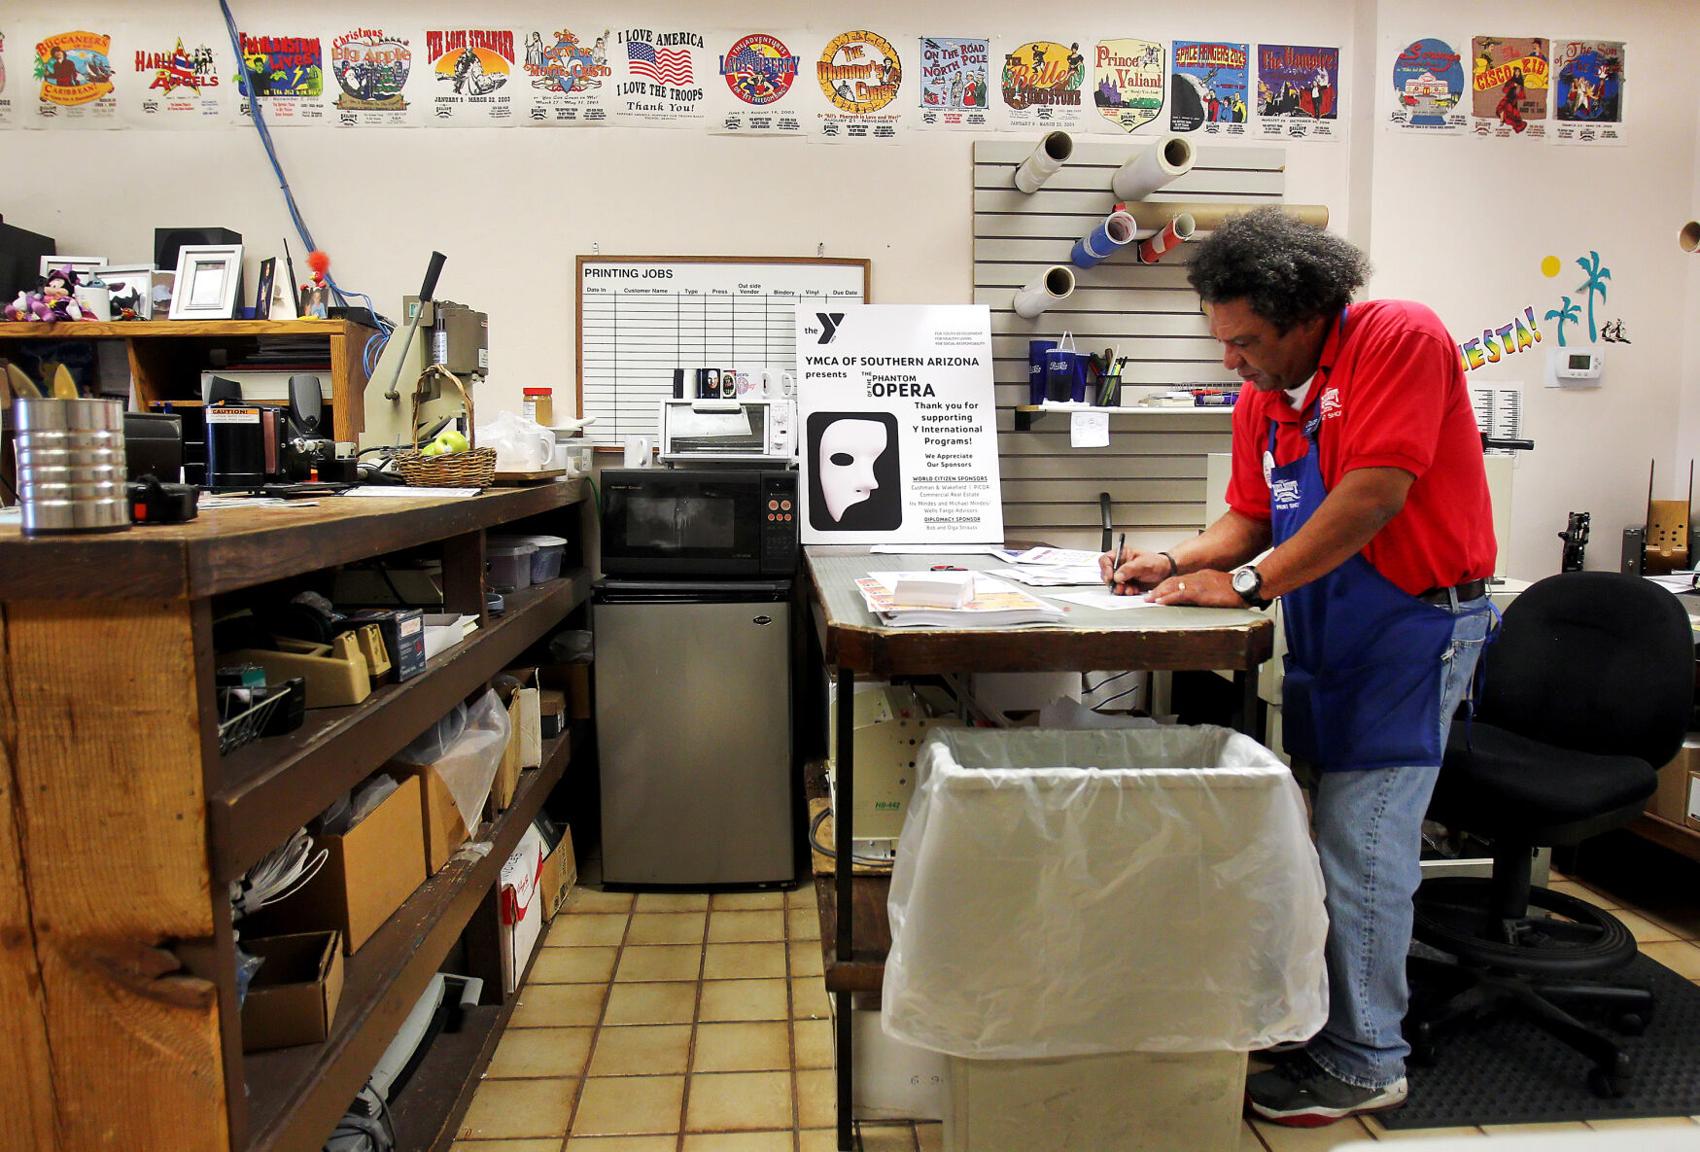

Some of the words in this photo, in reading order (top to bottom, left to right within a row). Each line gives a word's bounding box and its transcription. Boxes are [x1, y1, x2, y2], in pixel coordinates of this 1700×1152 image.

[333, 28, 383, 48] Christmas
[445, 31, 467, 52] LONE
[618, 32, 622, 44] I
[626, 29, 652, 42] LOVE
[656, 32, 704, 48] AMERICA
[924, 50, 939, 60] ON
[941, 49, 960, 60] THE
[960, 44, 985, 54] ROAD
[1096, 45, 1139, 68] Prince
[1566, 42, 1592, 58] The
[1597, 44, 1617, 56] Son
[923, 61, 960, 77] NORTH
[961, 55, 988, 66] POLE
[1554, 58, 1562, 68] of
[149, 71, 219, 90] ANGELS
[1010, 60, 1068, 88] Belle
[1116, 69, 1162, 88] Valiant
[1476, 65, 1512, 90] CISCO
[1522, 58, 1546, 74] KID
[617, 85, 620, 96] I
[624, 82, 646, 94] LOVE
[649, 84, 667, 98] THE
[670, 88, 704, 101] TROOPS
[627, 101, 664, 111] Thank
[669, 103, 694, 112] You!
[584, 268, 638, 278] PRINTING
[642, 269, 673, 278] JOBS
[1457, 306, 1542, 372] IESTA!
[806, 357, 838, 366] YMCA
[842, 357, 857, 366] OF
[861, 357, 923, 366] SOUTHERN
[928, 358, 980, 366] ARIZONA
[806, 371, 847, 379] presents
[872, 383, 935, 397] OPERA
[922, 414, 973, 423] supporting
[924, 437, 972, 446] Programs!
